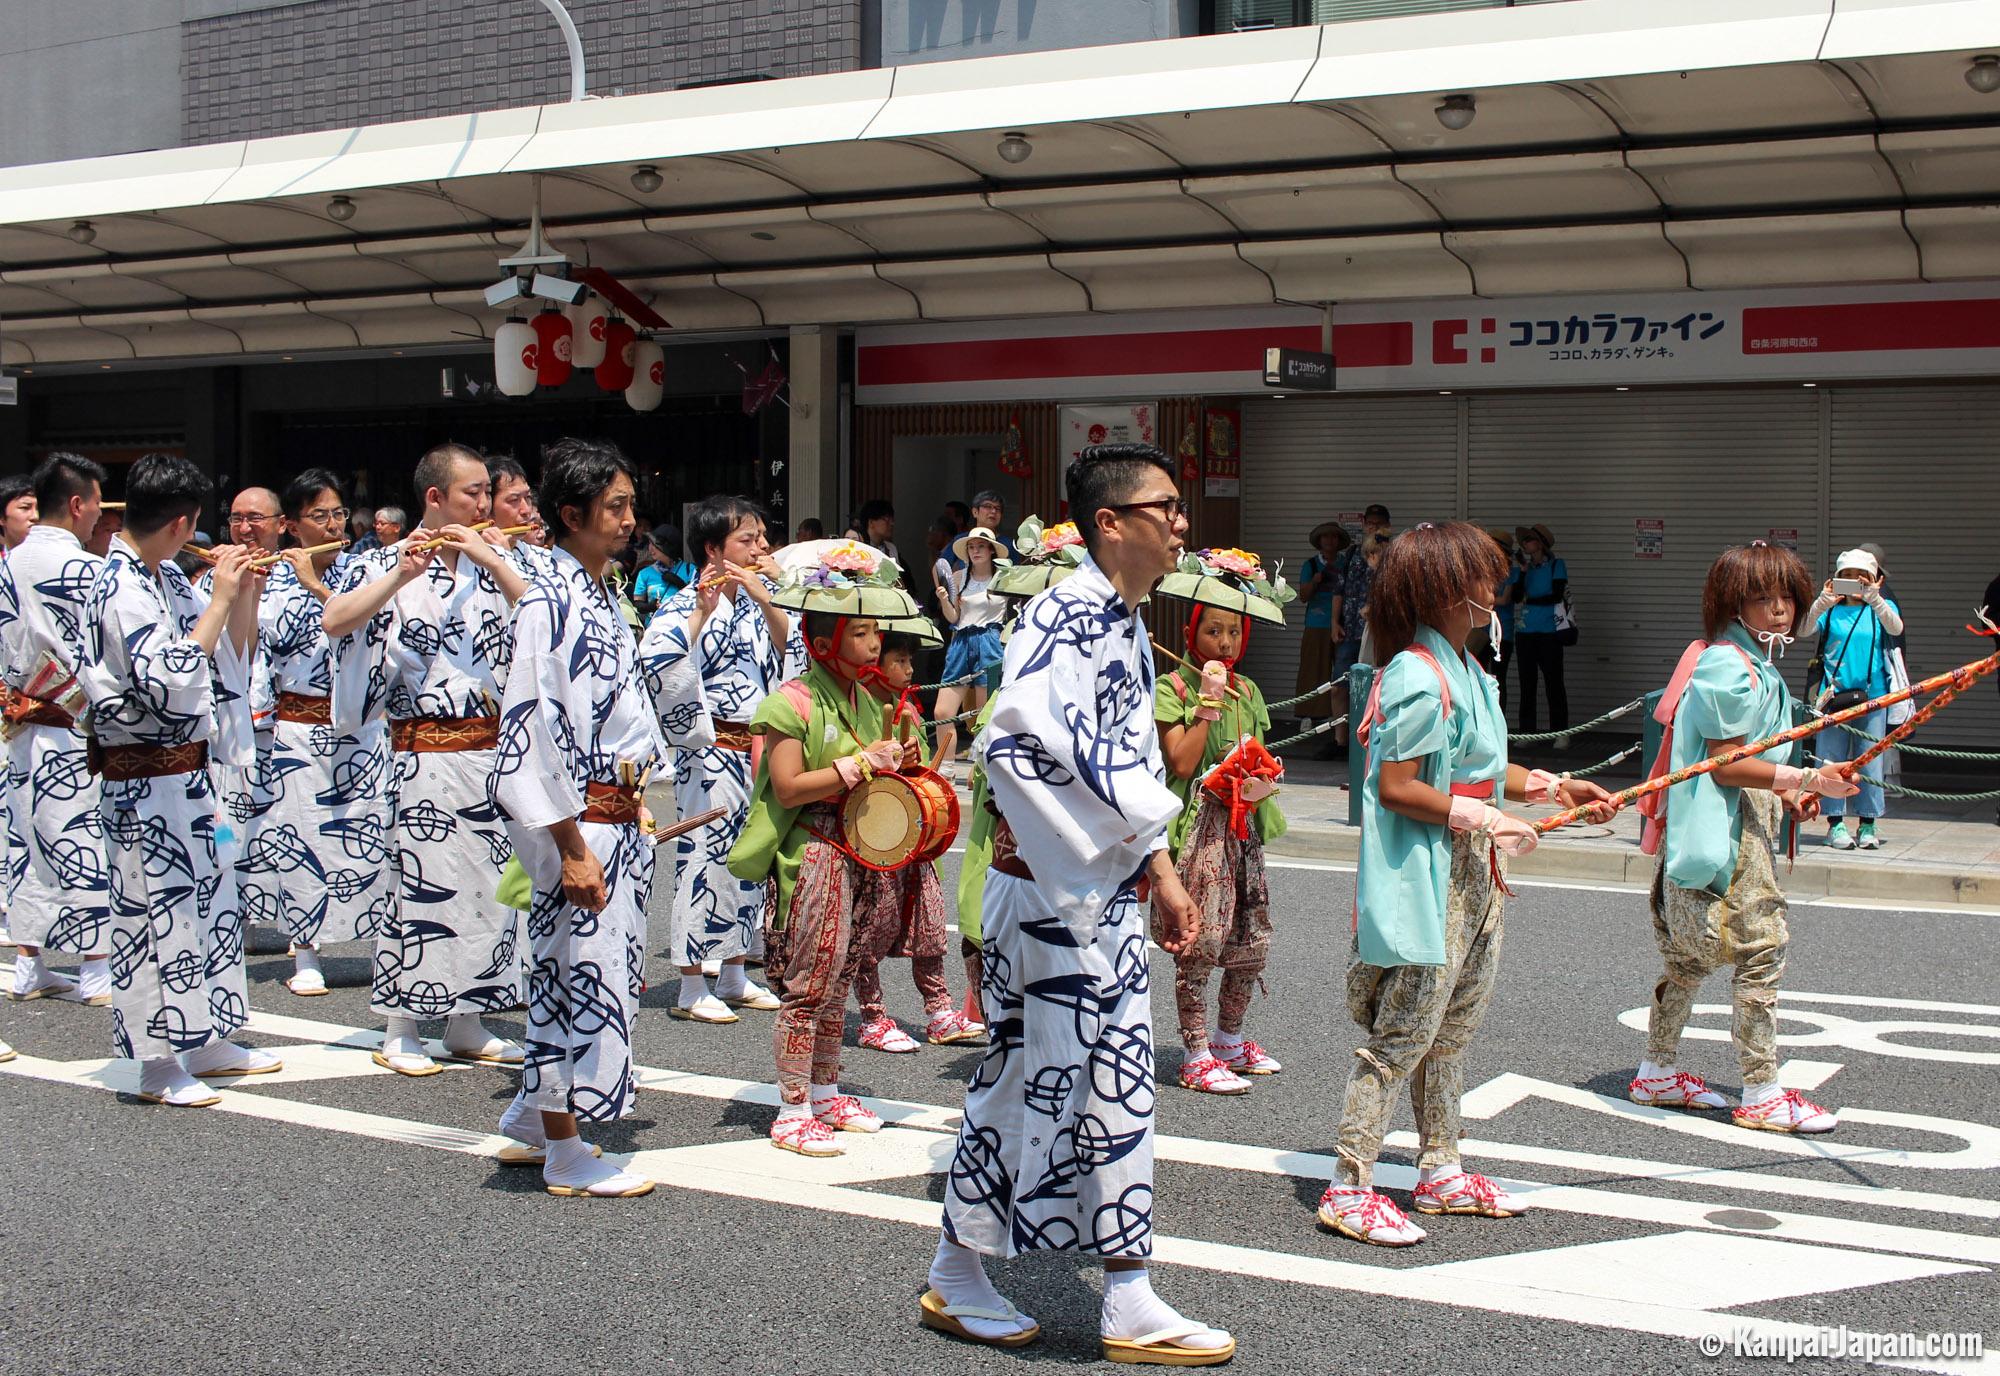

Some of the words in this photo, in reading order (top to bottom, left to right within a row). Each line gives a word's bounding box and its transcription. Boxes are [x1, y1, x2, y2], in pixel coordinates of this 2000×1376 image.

[1510, 312, 1725, 346] ココカラファイン
[1549, 346, 1675, 360] ココロ、カラダ、ゲンキ。
